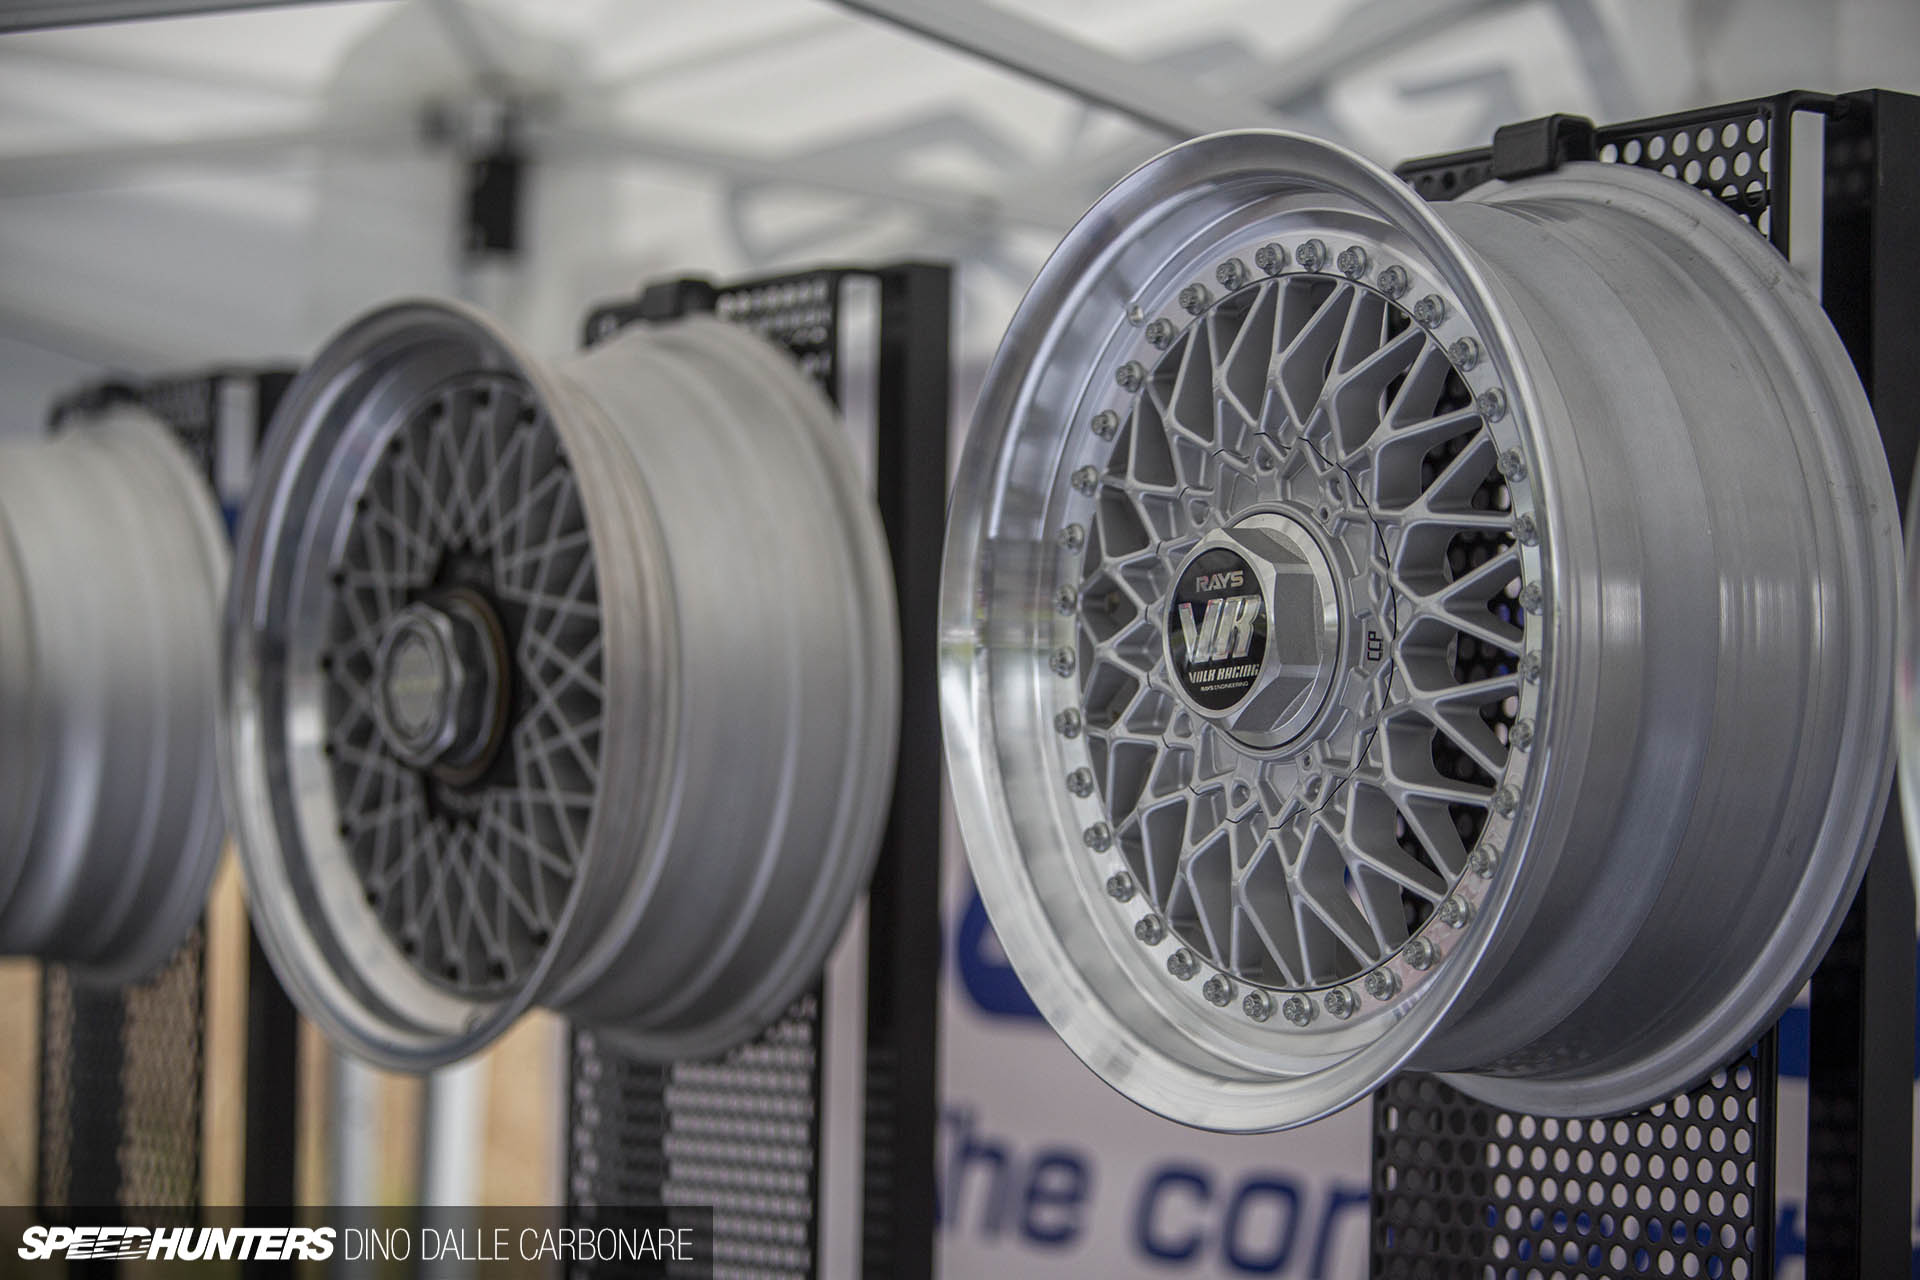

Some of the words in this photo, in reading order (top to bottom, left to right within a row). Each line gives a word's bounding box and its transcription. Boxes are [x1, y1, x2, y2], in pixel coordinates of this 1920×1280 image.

[1196, 570, 1244, 593] RAYS
[1367, 630, 1384, 662] CCP
[1188, 669, 1217, 684] VOLK
[1217, 664, 1260, 681] RACING
